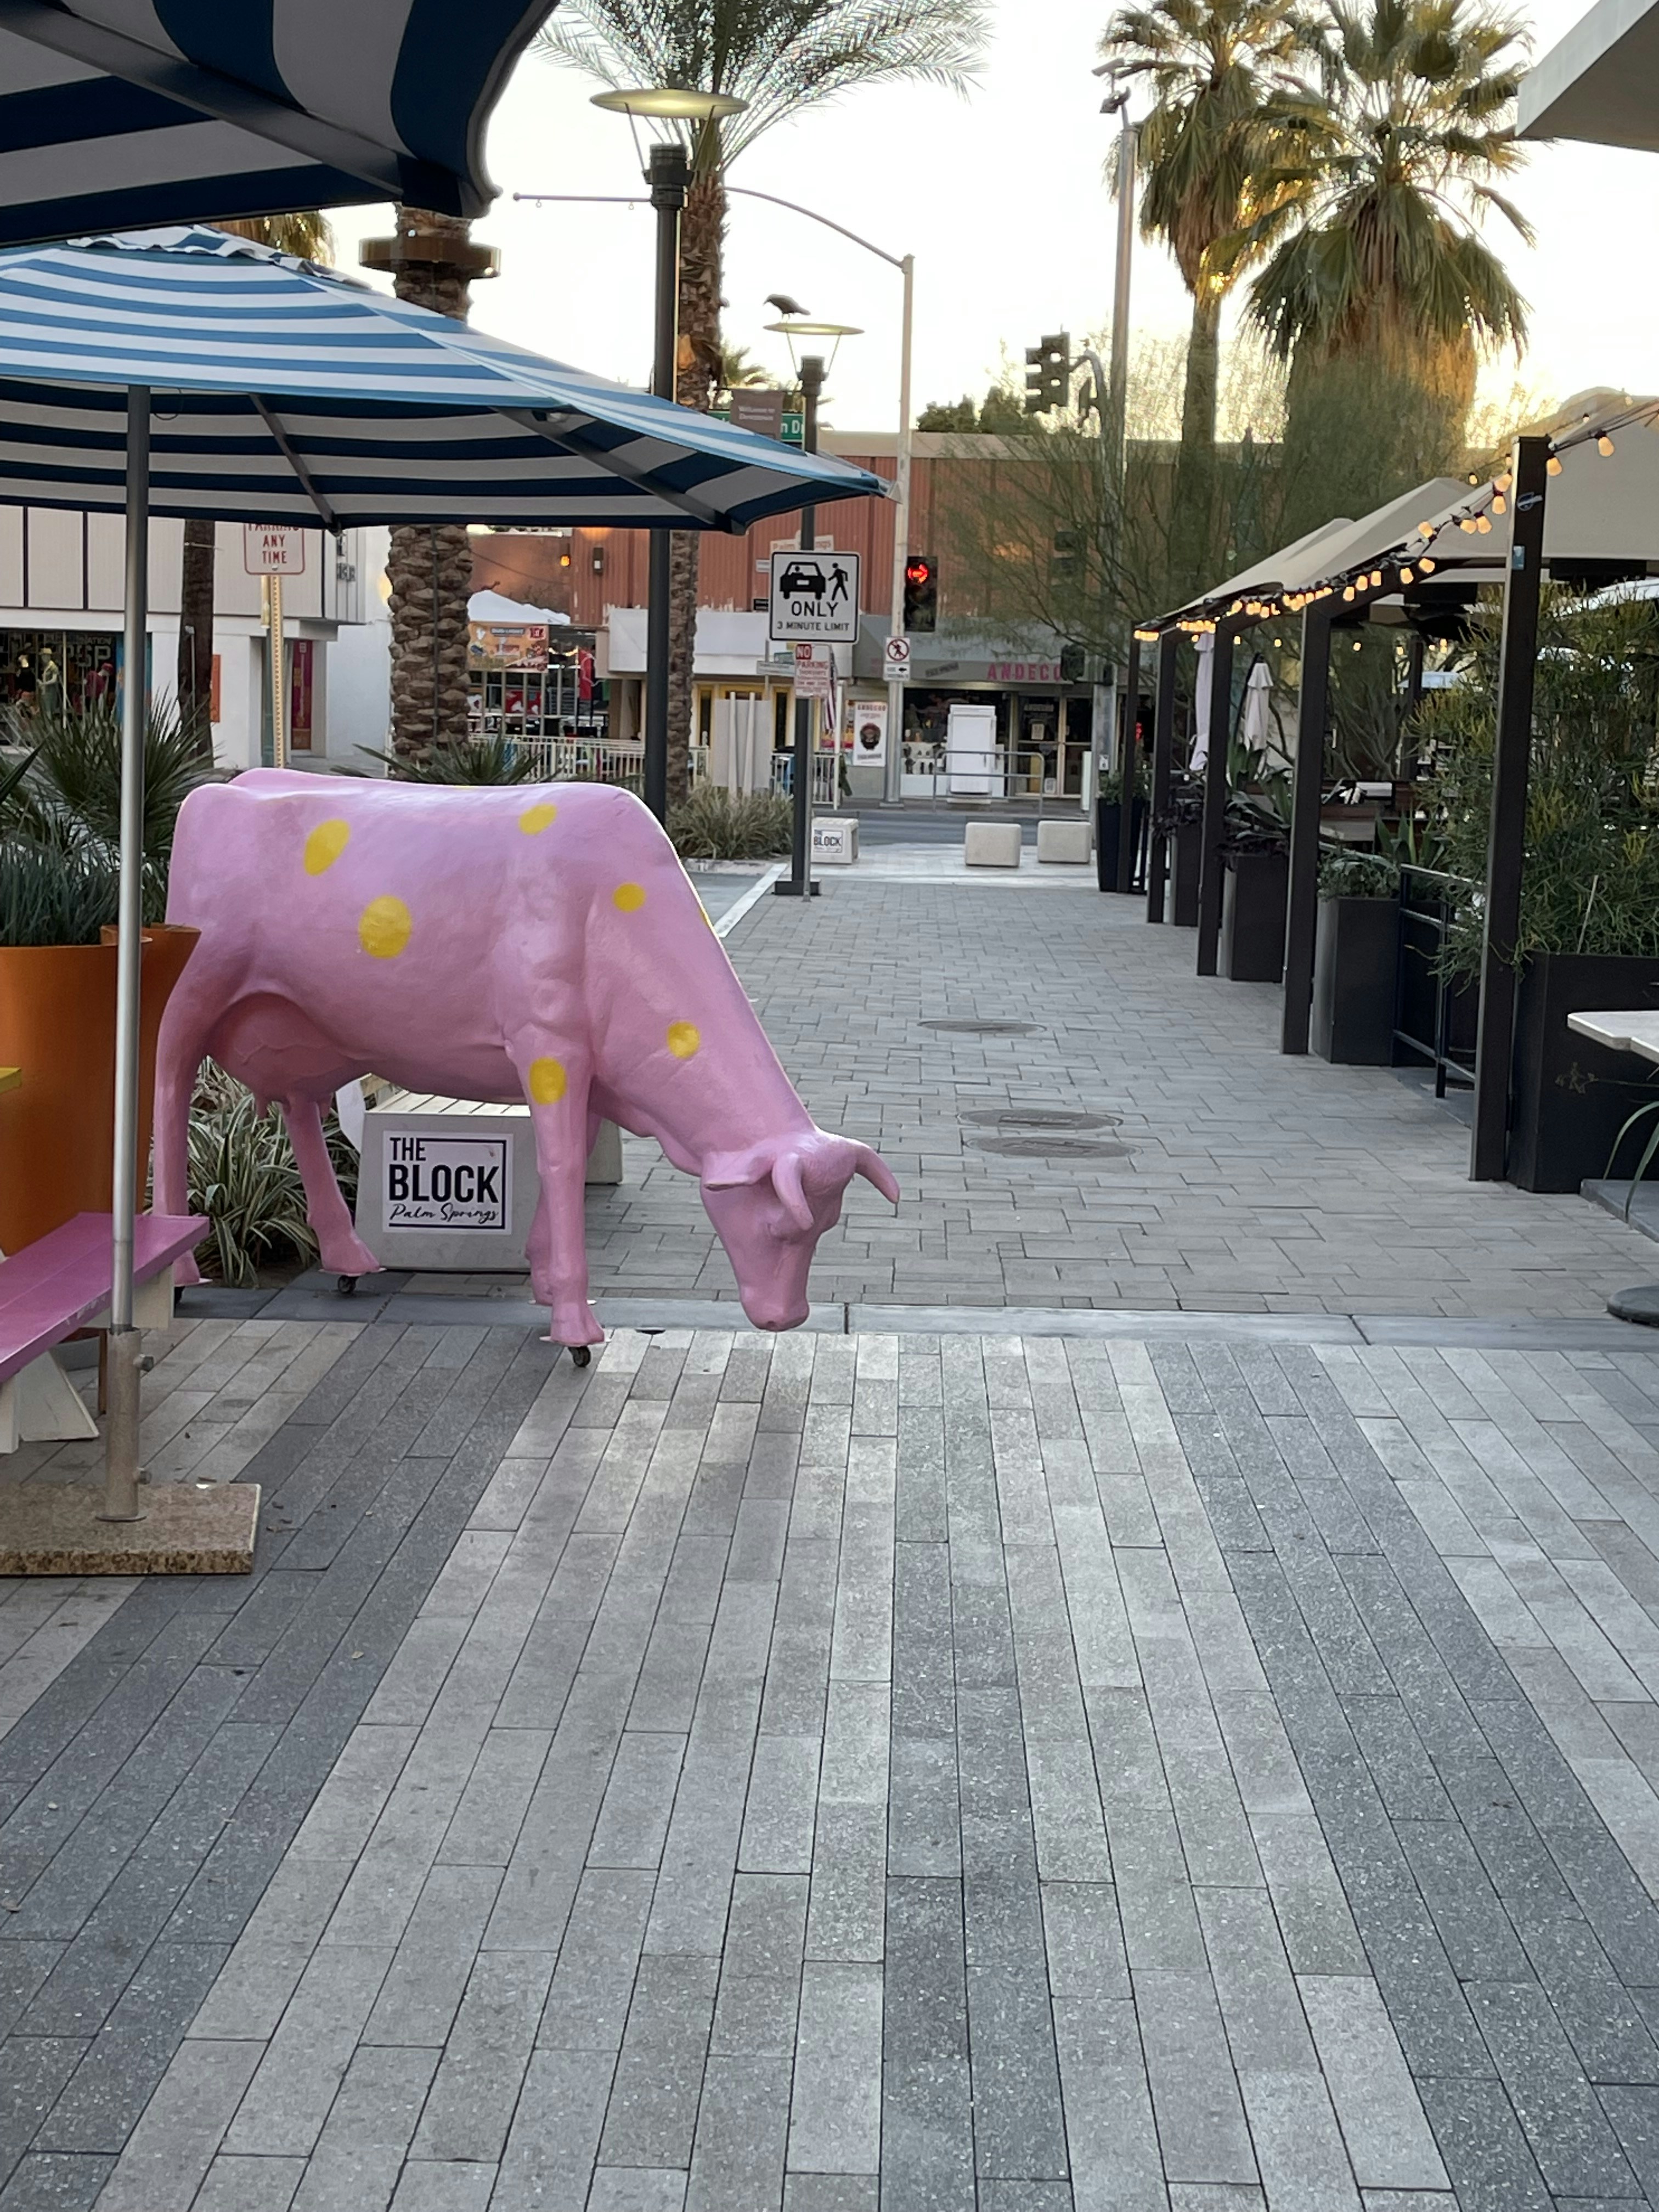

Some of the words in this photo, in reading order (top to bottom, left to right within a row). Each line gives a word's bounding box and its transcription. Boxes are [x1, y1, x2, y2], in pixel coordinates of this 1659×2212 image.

[263, 534, 286, 548] ANY
[262, 550, 287, 564] TIME
[791, 601, 839, 617] ONLY
[777, 621, 783, 630] 3
[786, 622, 821, 630] MINUTE
[825, 622, 850, 631] LIMIT
[797, 646, 810, 658] NO
[814, 836, 842, 847] BLOCK
[390, 1137, 426, 1161] THE
[389, 1164, 499, 1203] BLOCK
[390, 1203, 436, 1220] Palm
[440, 1202, 499, 1224] Springs
